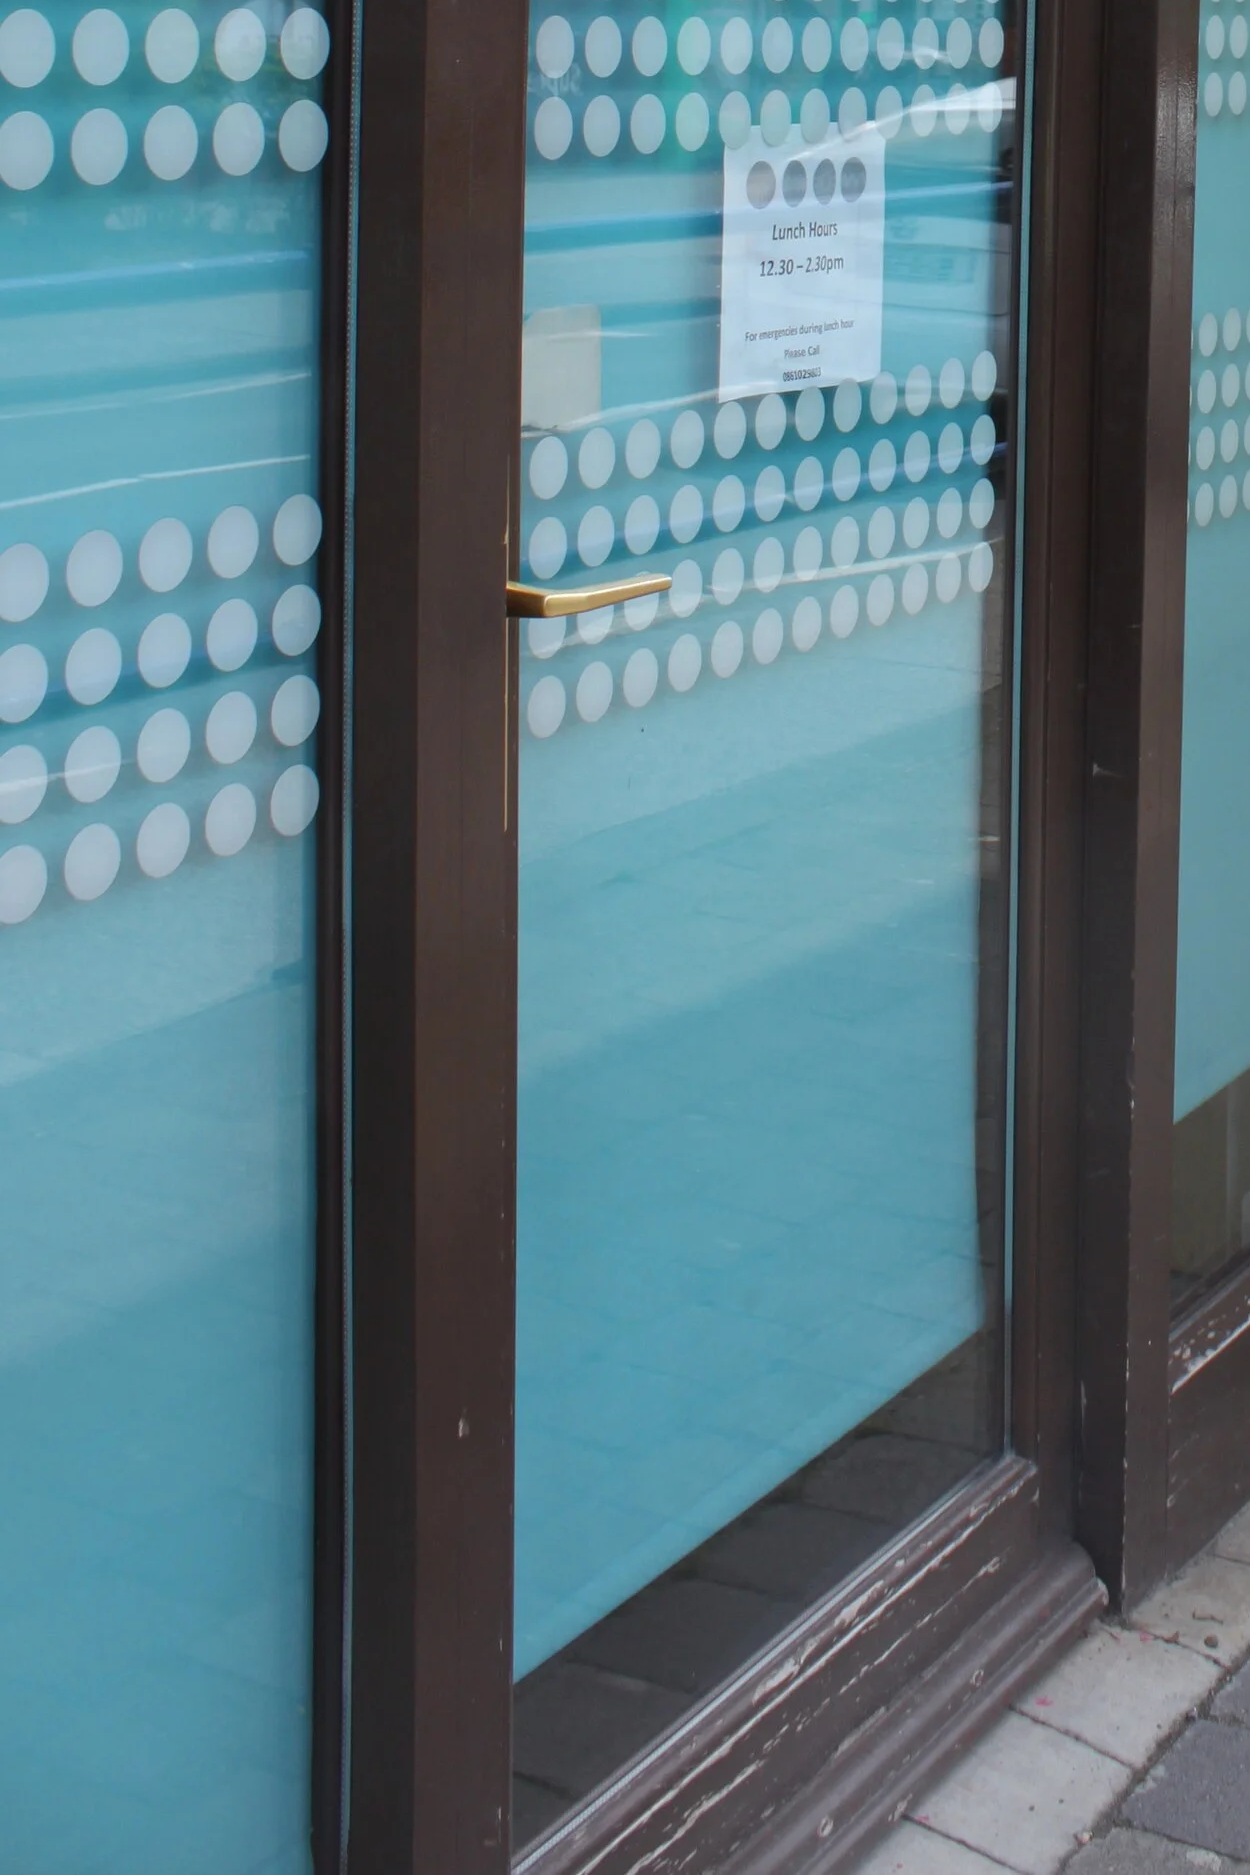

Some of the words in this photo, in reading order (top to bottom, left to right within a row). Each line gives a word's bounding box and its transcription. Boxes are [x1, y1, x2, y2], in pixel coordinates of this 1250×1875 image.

[772, 222, 805, 241] Lunch
[809, 221, 838, 238] Hours
[760, 259, 794, 277] 12.30
[805, 255, 844, 274] 2.30pm
[745, 331, 758, 342] For
[759, 325, 798, 340] emergencies
[799, 321, 823, 335] during
[784, 348, 806, 359] Please
[807, 344, 821, 356] Call
